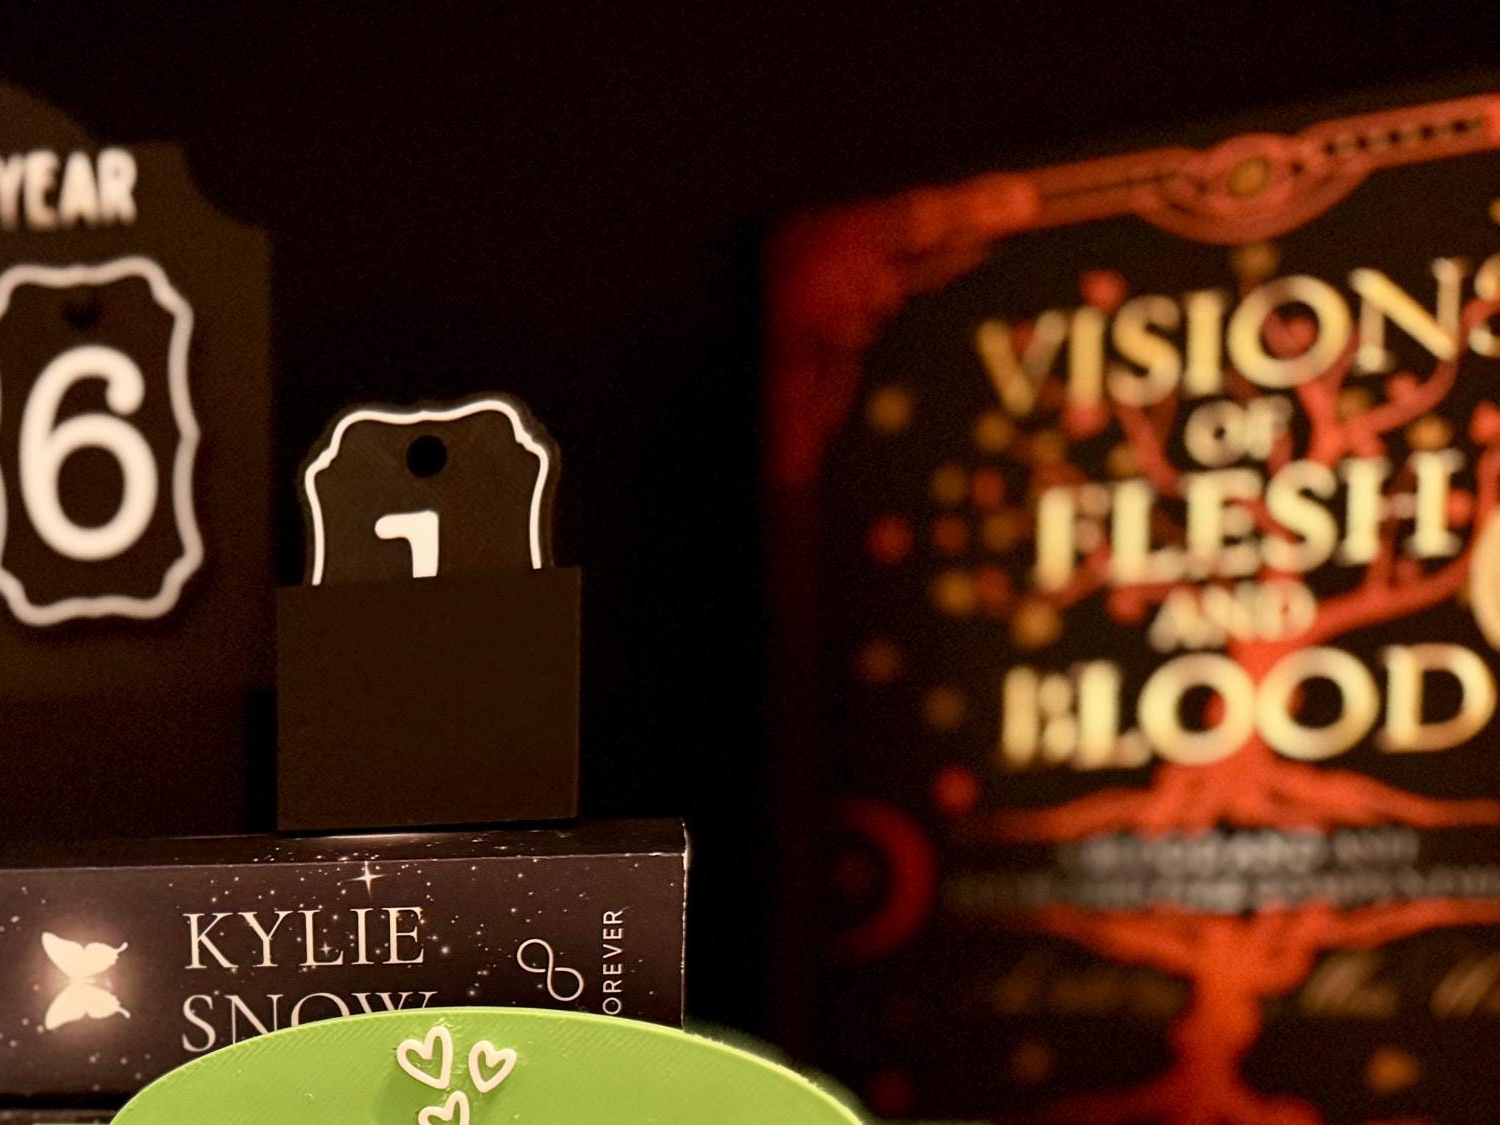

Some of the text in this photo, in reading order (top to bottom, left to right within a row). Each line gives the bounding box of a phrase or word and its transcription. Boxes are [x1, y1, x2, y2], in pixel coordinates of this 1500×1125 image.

[1184, 397, 1291, 466] OF
[1034, 450, 1462, 591] FLESH
[1150, 582, 1316, 647] AND
[1002, 646, 1496, 767] BLOOD
[183, 907, 425, 970] KYLIE
[602, 909, 624, 1016] OREVER
[182, 991, 438, 1052] SN
